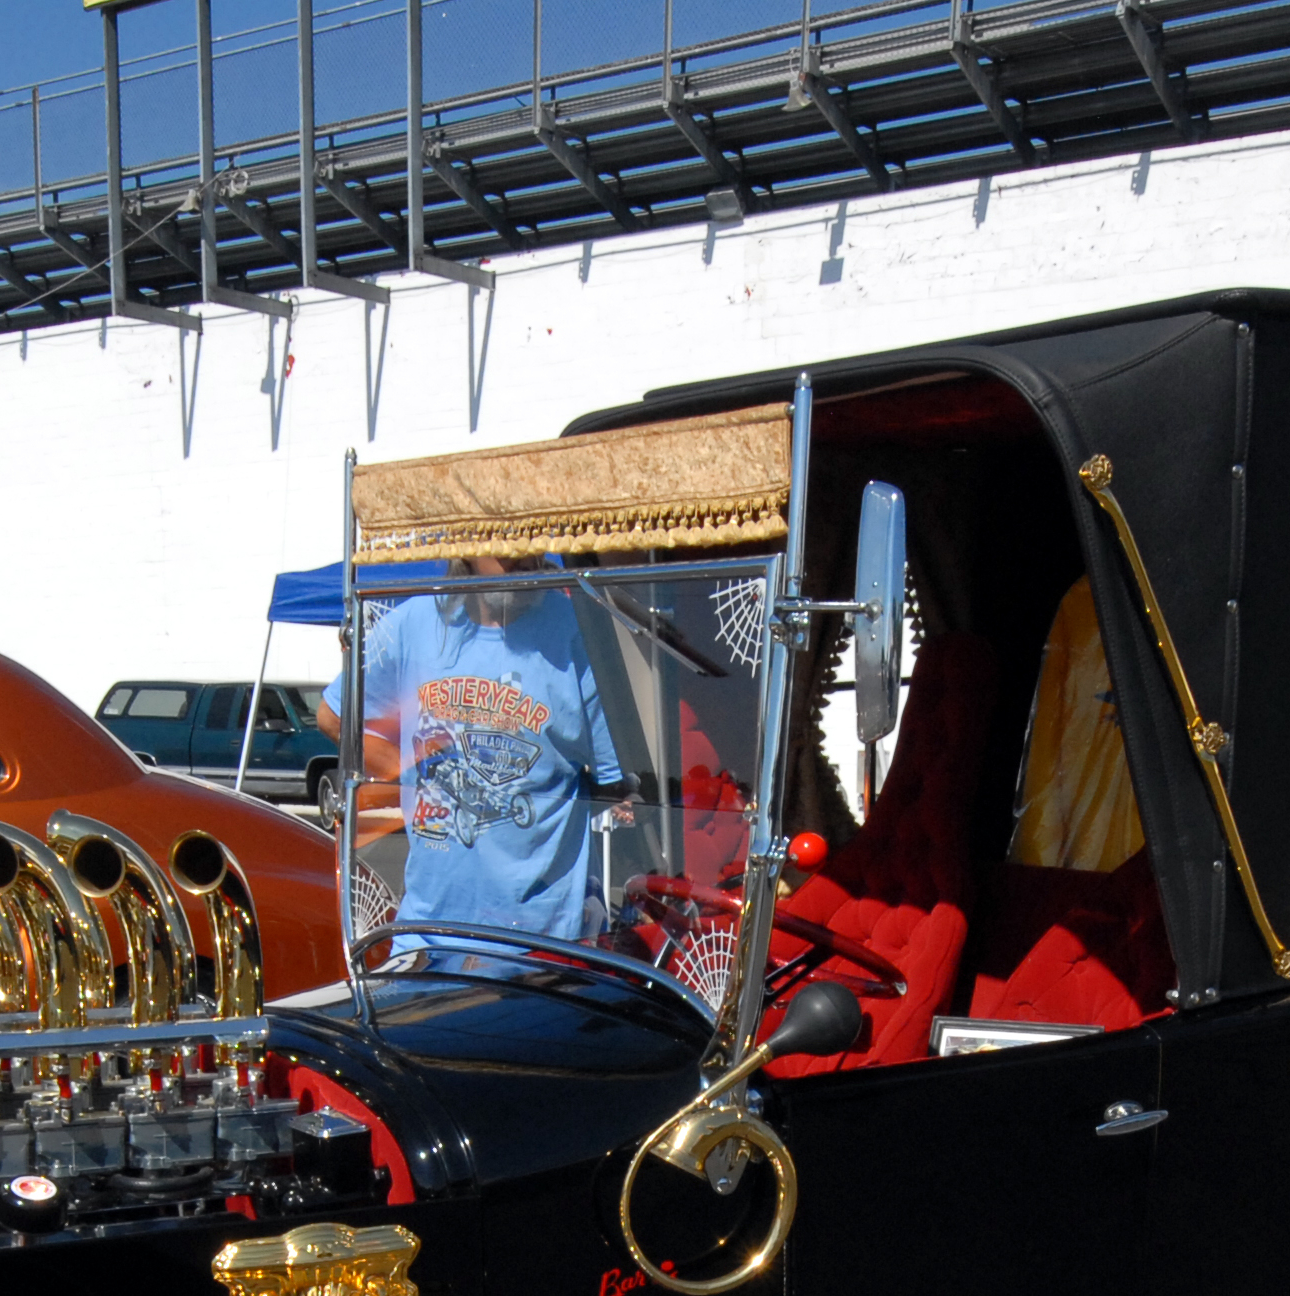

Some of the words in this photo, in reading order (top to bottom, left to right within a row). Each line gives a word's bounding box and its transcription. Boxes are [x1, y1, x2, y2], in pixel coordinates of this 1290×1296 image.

[418, 676, 550, 736] YESTERYEAR
[434, 704, 458, 721] DRAG
[469, 709, 490, 724] CAR
[491, 712, 520, 732] SHOW
